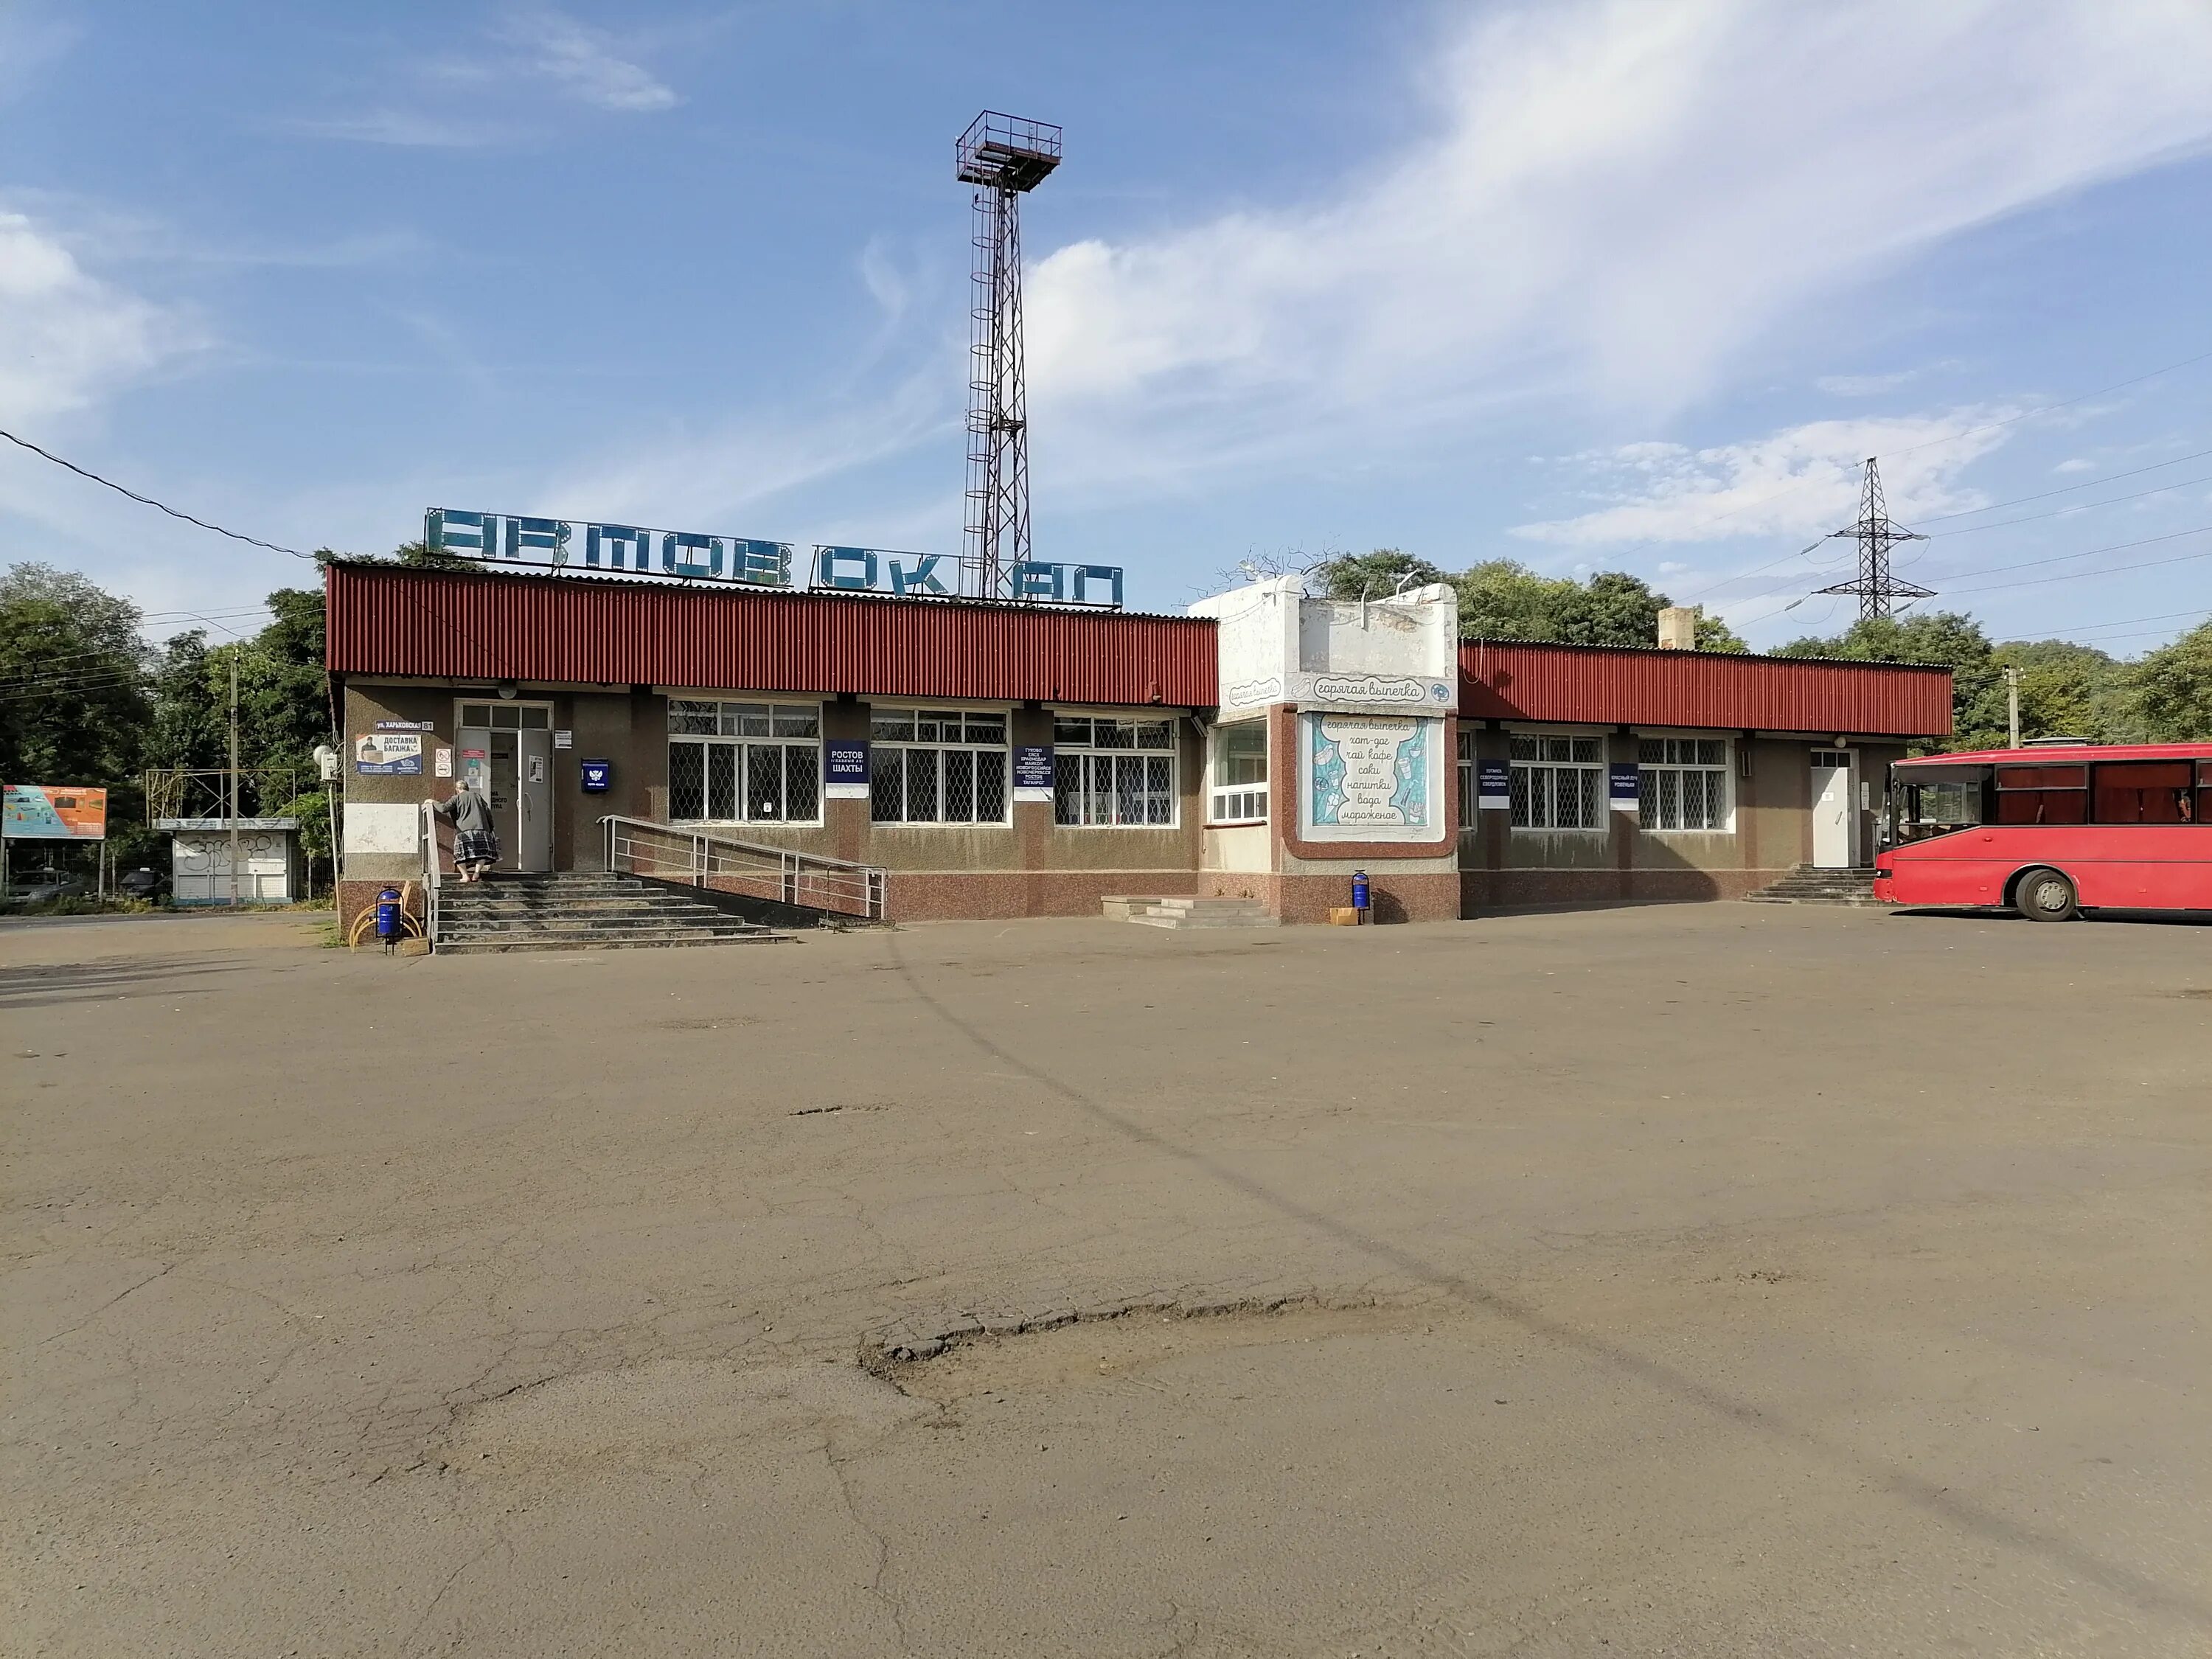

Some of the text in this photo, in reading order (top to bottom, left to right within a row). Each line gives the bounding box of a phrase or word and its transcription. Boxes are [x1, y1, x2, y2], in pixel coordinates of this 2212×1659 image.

[1318, 681, 1420, 698] горячая выпечка
[386, 721, 421, 729] ХАРЬКОВСКАЯ
[1326, 717, 1410, 734] горячая выпечка
[384, 737, 417, 745] ДОСТАВКА
[1349, 737, 1389, 748] хот-дог
[832, 751, 863, 759] РОСТОВ
[1346, 748, 1392, 765] чай кофе
[832, 764, 863, 773] ШАХТЫ
[1358, 763, 1380, 775] соки
[1346, 778, 1391, 790] напитки
[1357, 793, 1381, 808] вода
[1341, 809, 1397, 823] мороженое
